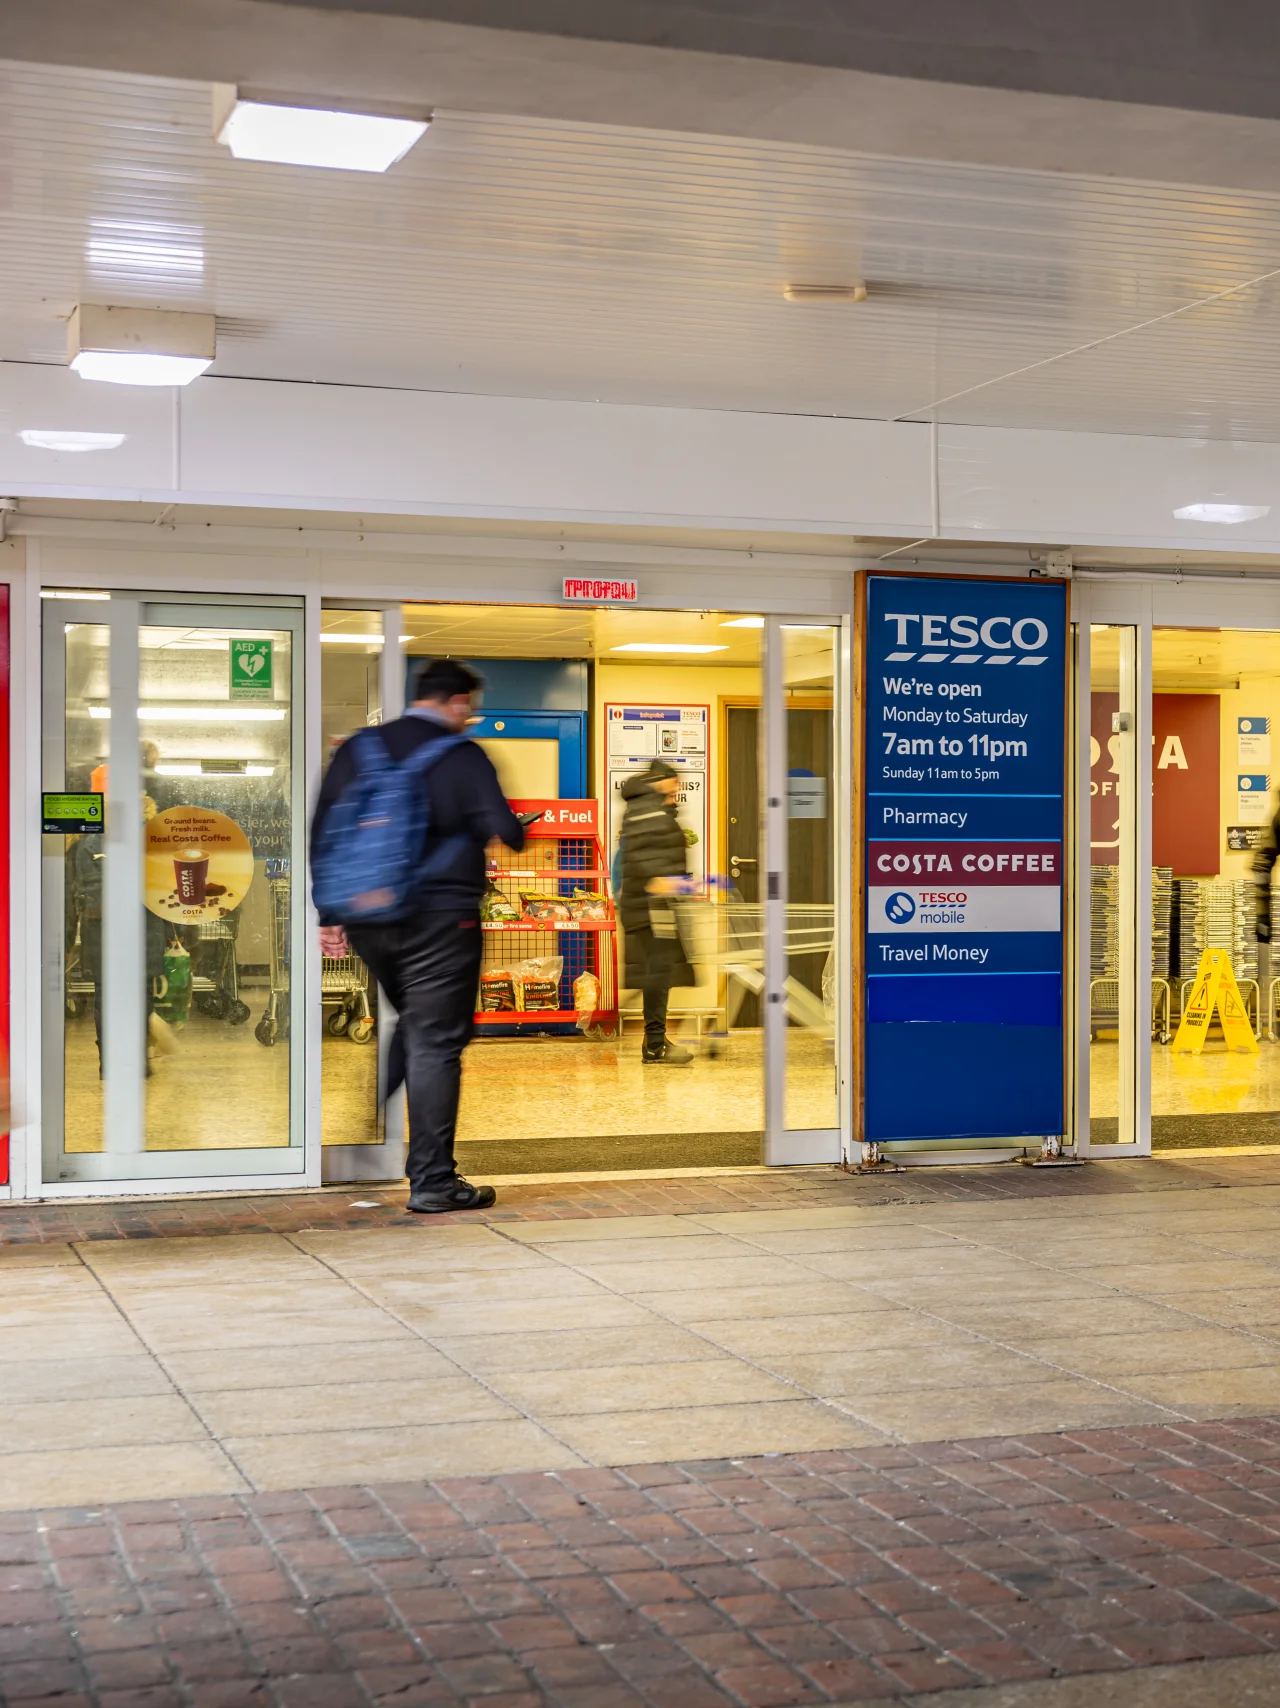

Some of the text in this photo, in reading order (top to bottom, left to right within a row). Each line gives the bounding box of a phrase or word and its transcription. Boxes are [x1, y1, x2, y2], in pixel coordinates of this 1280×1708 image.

[884, 613, 1049, 650] TESCO
[235, 643, 255, 651] AED
[883, 677, 982, 700] We're open
[883, 706, 1028, 727] Monday to Saturday
[882, 732, 1028, 761] 7am to 11pm
[883, 766, 999, 781] Sunday 11am to 5pm
[678, 781, 701, 791] HIS?
[90, 807, 96, 815] 5
[544, 810, 556, 823] &
[559, 810, 592, 823] Fuel
[883, 807, 968, 828] Pharmacy
[150, 835, 170, 843] Real
[173, 835, 199, 843] Costa
[254, 836, 285, 847] your
[877, 854, 1055, 875] COSTA COFFEE
[182, 870, 190, 897] COSTA
[919, 893, 967, 903] TESCO
[921, 911, 965, 923] mobile
[879, 945, 989, 963] Travel Money
